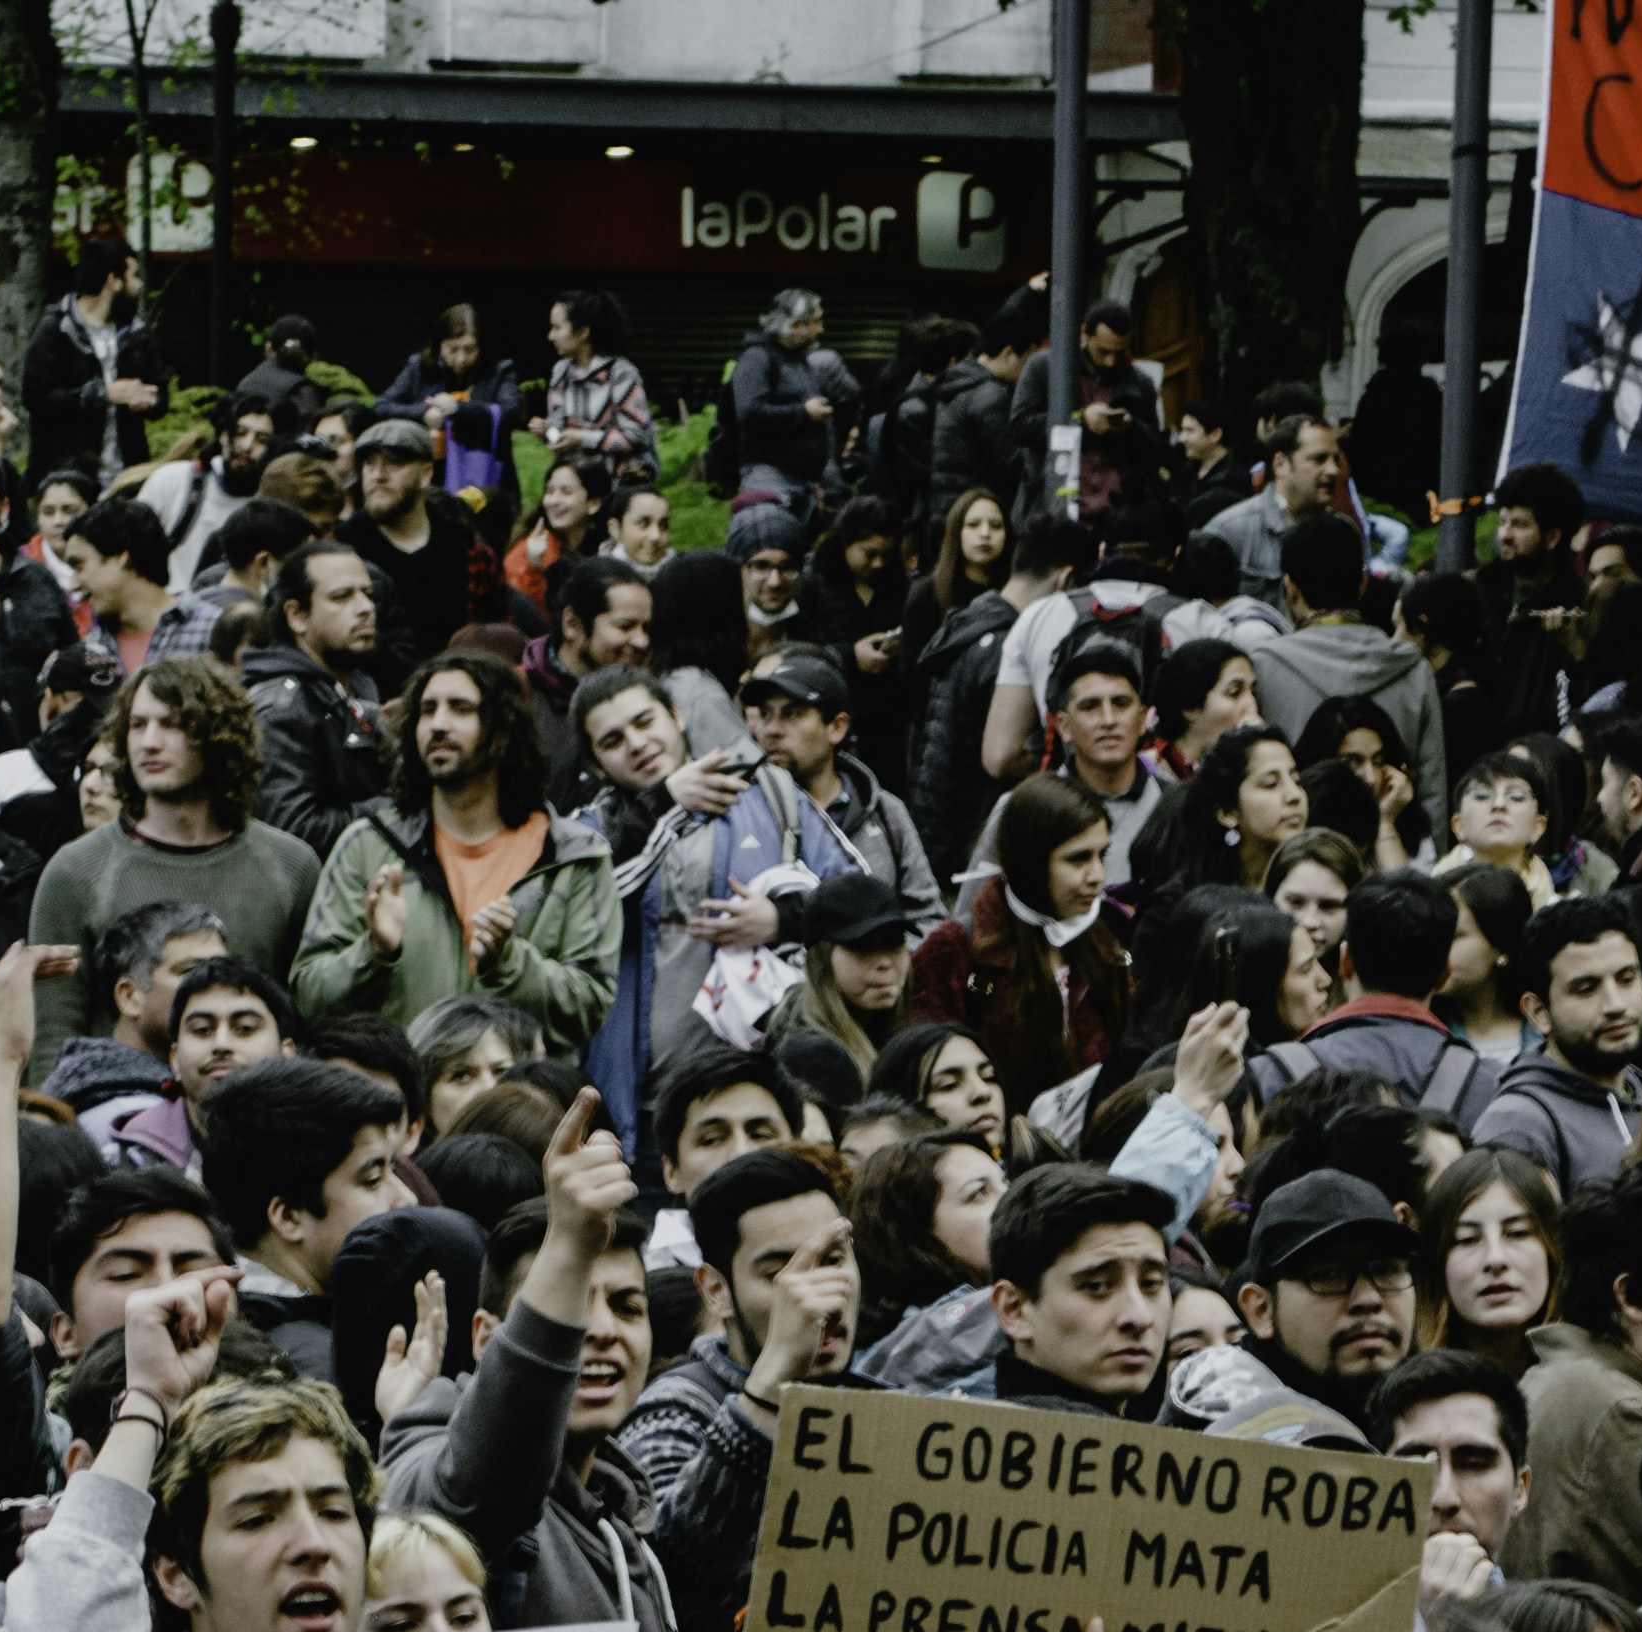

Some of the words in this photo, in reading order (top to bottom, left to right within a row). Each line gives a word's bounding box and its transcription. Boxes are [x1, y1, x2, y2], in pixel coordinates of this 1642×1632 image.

[680, 186, 898, 252] laPolar
[793, 1407, 873, 1474] EL
[915, 1421, 1241, 1514] GOBIERNO
[1262, 1466, 1418, 1535] ROBA
[777, 1490, 855, 1550] LA
[886, 1501, 1088, 1576] POLICIA
[1124, 1529, 1271, 1602] MATA
[765, 1570, 844, 1632] LA
